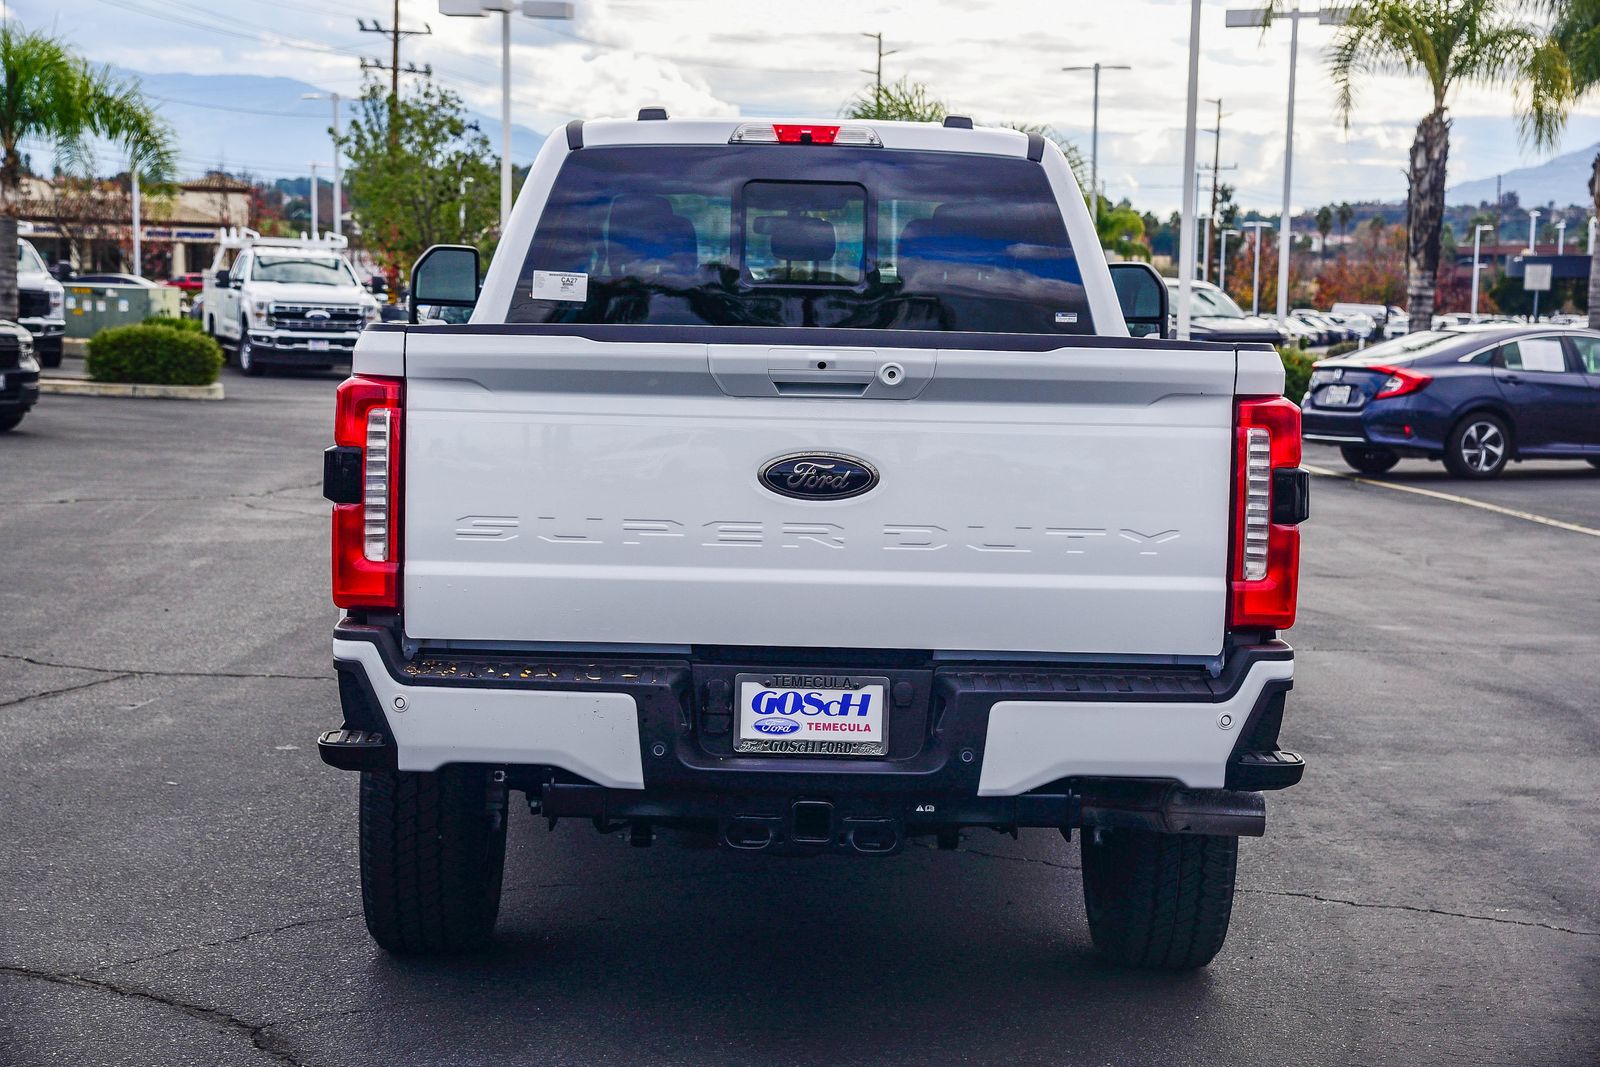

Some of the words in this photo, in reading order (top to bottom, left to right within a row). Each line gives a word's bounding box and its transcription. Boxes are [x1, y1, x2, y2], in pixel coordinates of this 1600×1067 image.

[787, 462, 851, 490] Ford
[455, 514, 846, 550] SUPER
[882, 523, 1182, 556] DUTY
[773, 675, 852, 689] TEMECULA
[761, 718, 793, 733] Ford
[807, 722, 872, 733] TEMECULA
[820, 741, 853, 755] FORD
